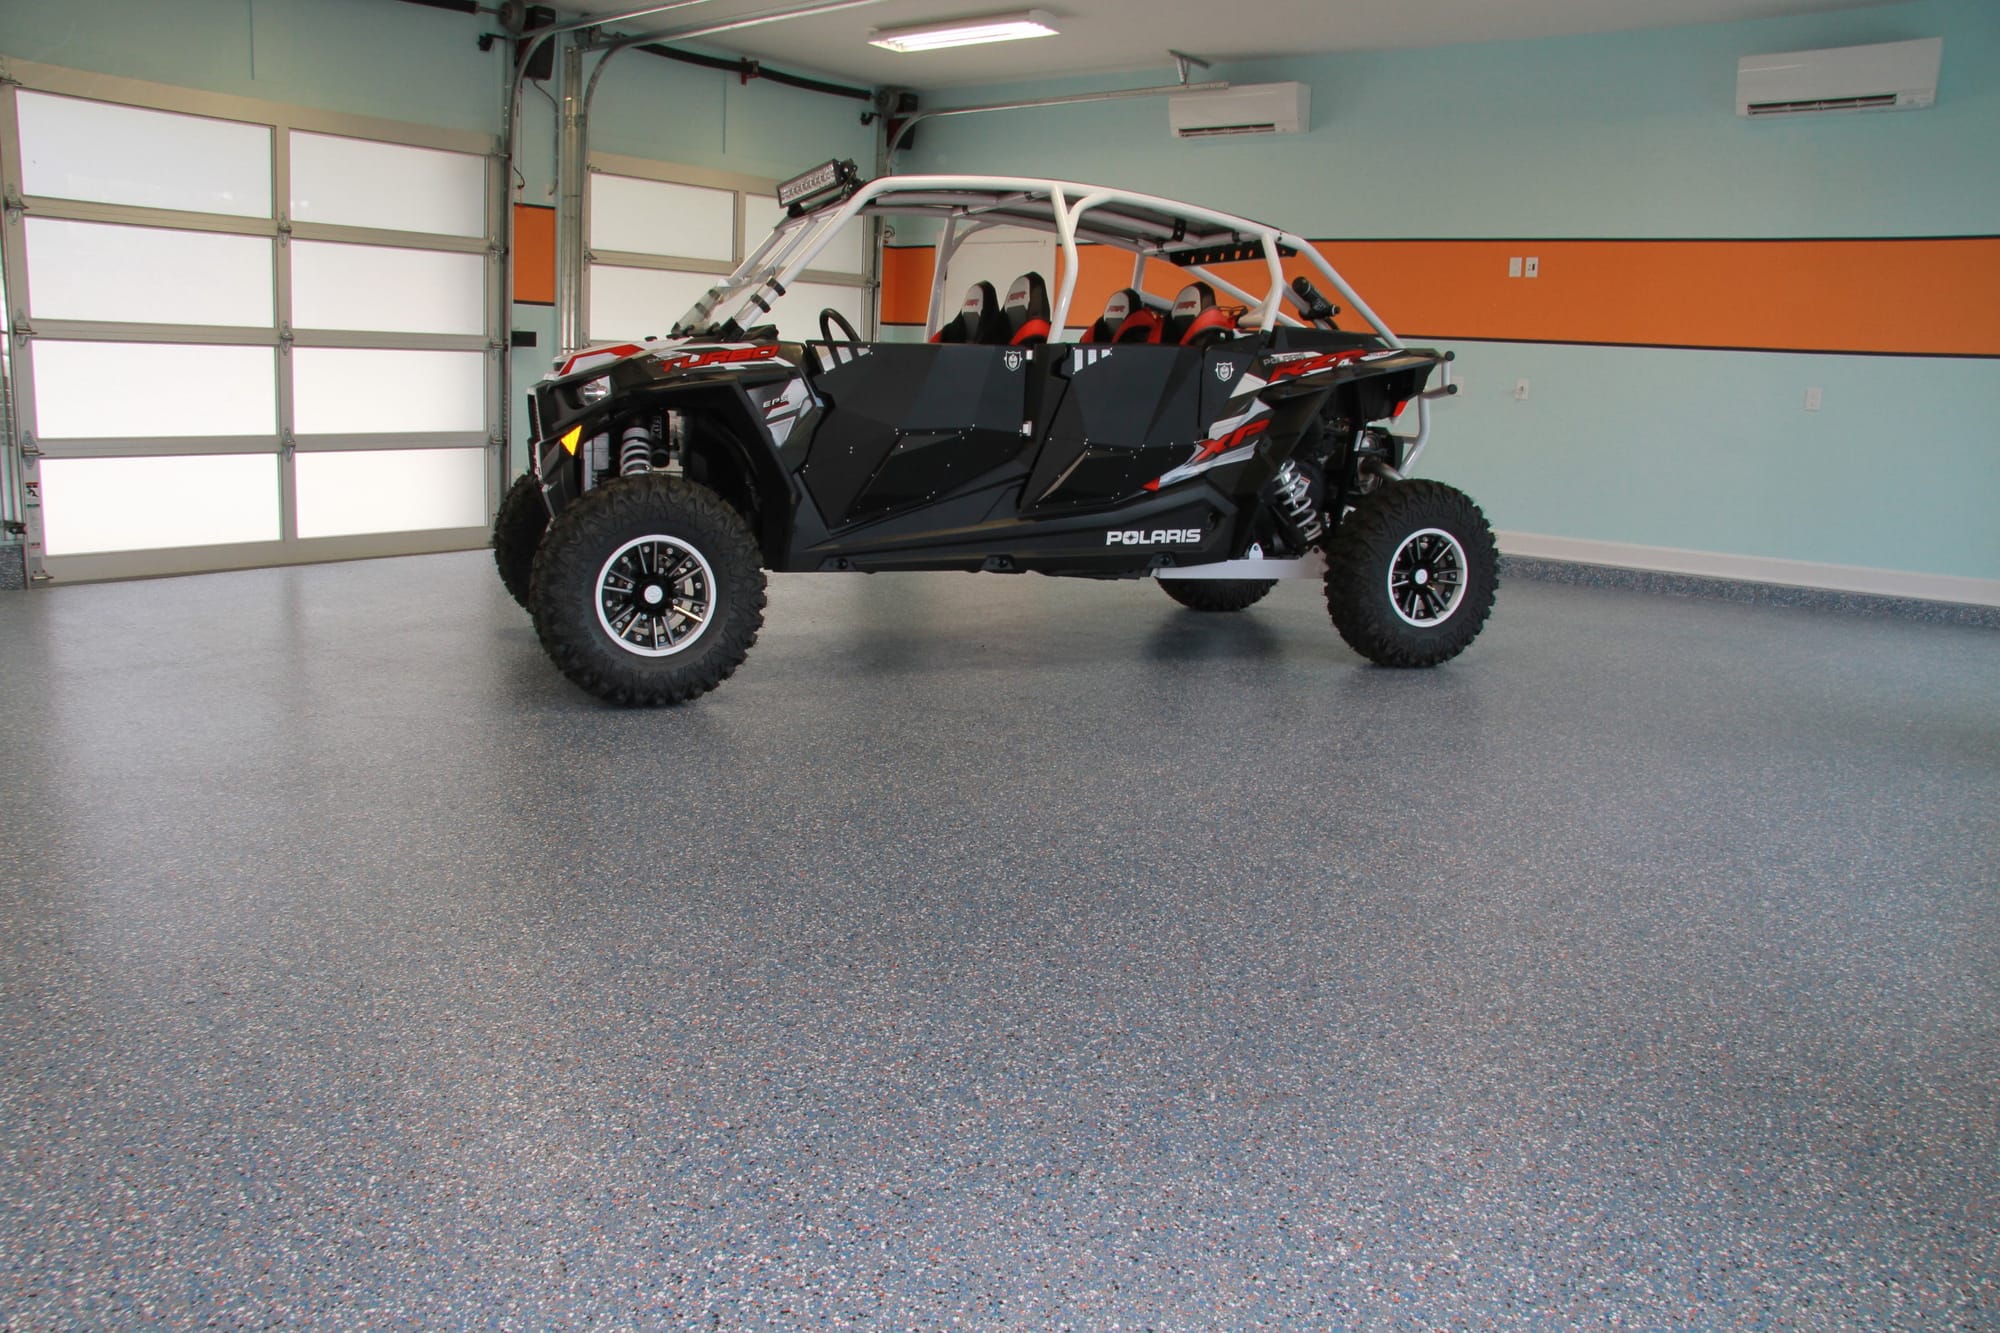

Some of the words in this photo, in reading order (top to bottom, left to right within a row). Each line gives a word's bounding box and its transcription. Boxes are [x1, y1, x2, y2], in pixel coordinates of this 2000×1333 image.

[659, 345, 779, 373] TURBO
[1193, 418, 1271, 463] XP
[1105, 528, 1201, 546] POLARIS
